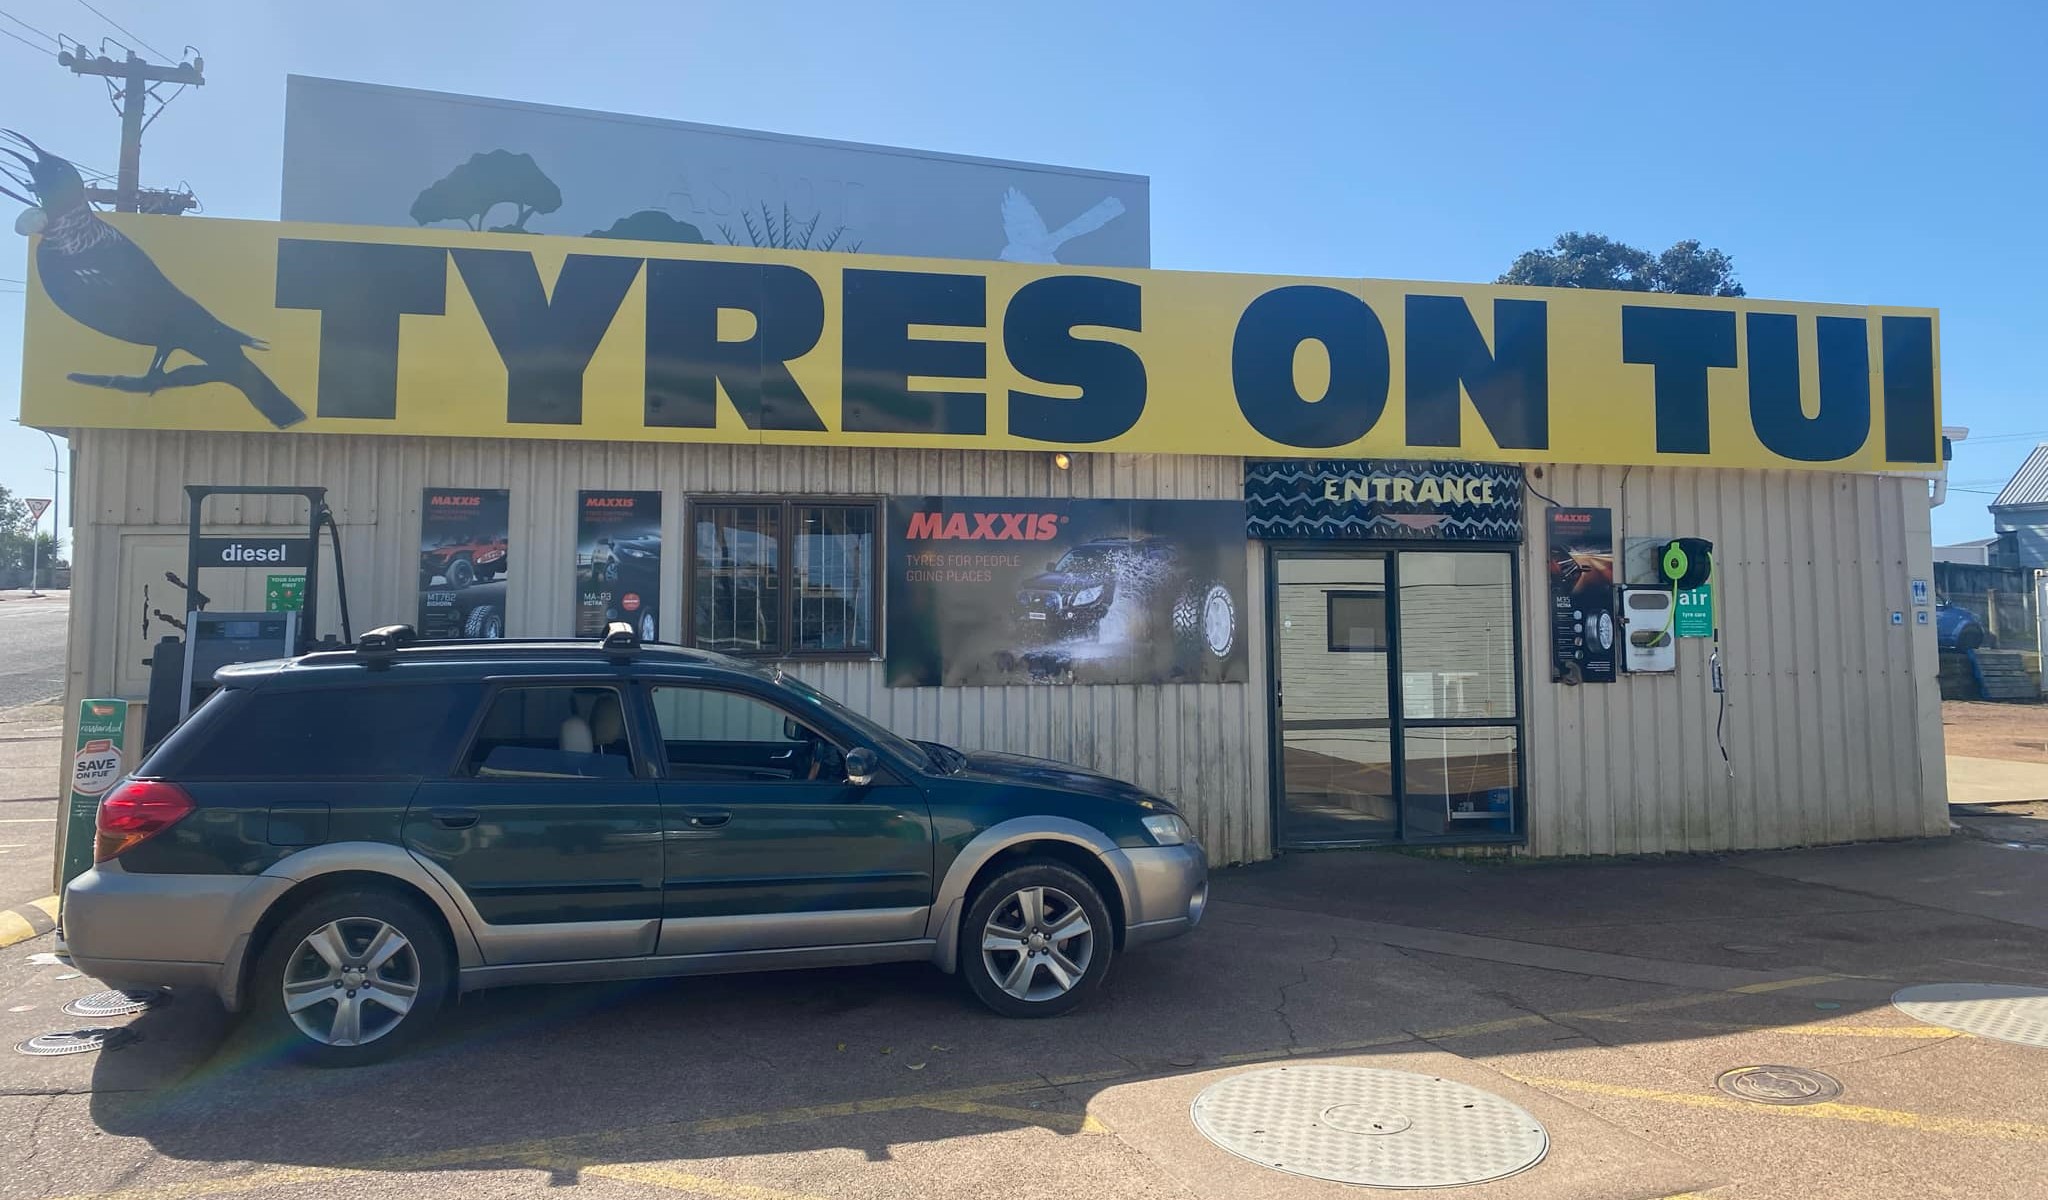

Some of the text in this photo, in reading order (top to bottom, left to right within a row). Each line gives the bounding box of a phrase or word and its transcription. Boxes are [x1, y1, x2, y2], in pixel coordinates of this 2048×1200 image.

[275, 238, 1936, 463] TYRES ON TUI
[1324, 477, 1494, 503] ENTRANCE
[431, 496, 480, 506] MAXXIS
[585, 497, 634, 507] MAXXIS
[1554, 513, 1591, 522] MAXXIS
[906, 512, 1058, 541] MAXXIS
[222, 544, 286, 561] diesel
[906, 555, 1021, 567] TYRES FOR PEOPLE
[906, 570, 992, 582] GOING PLACES
[1679, 589, 1708, 605] air
[77, 759, 116, 771] SAVE
